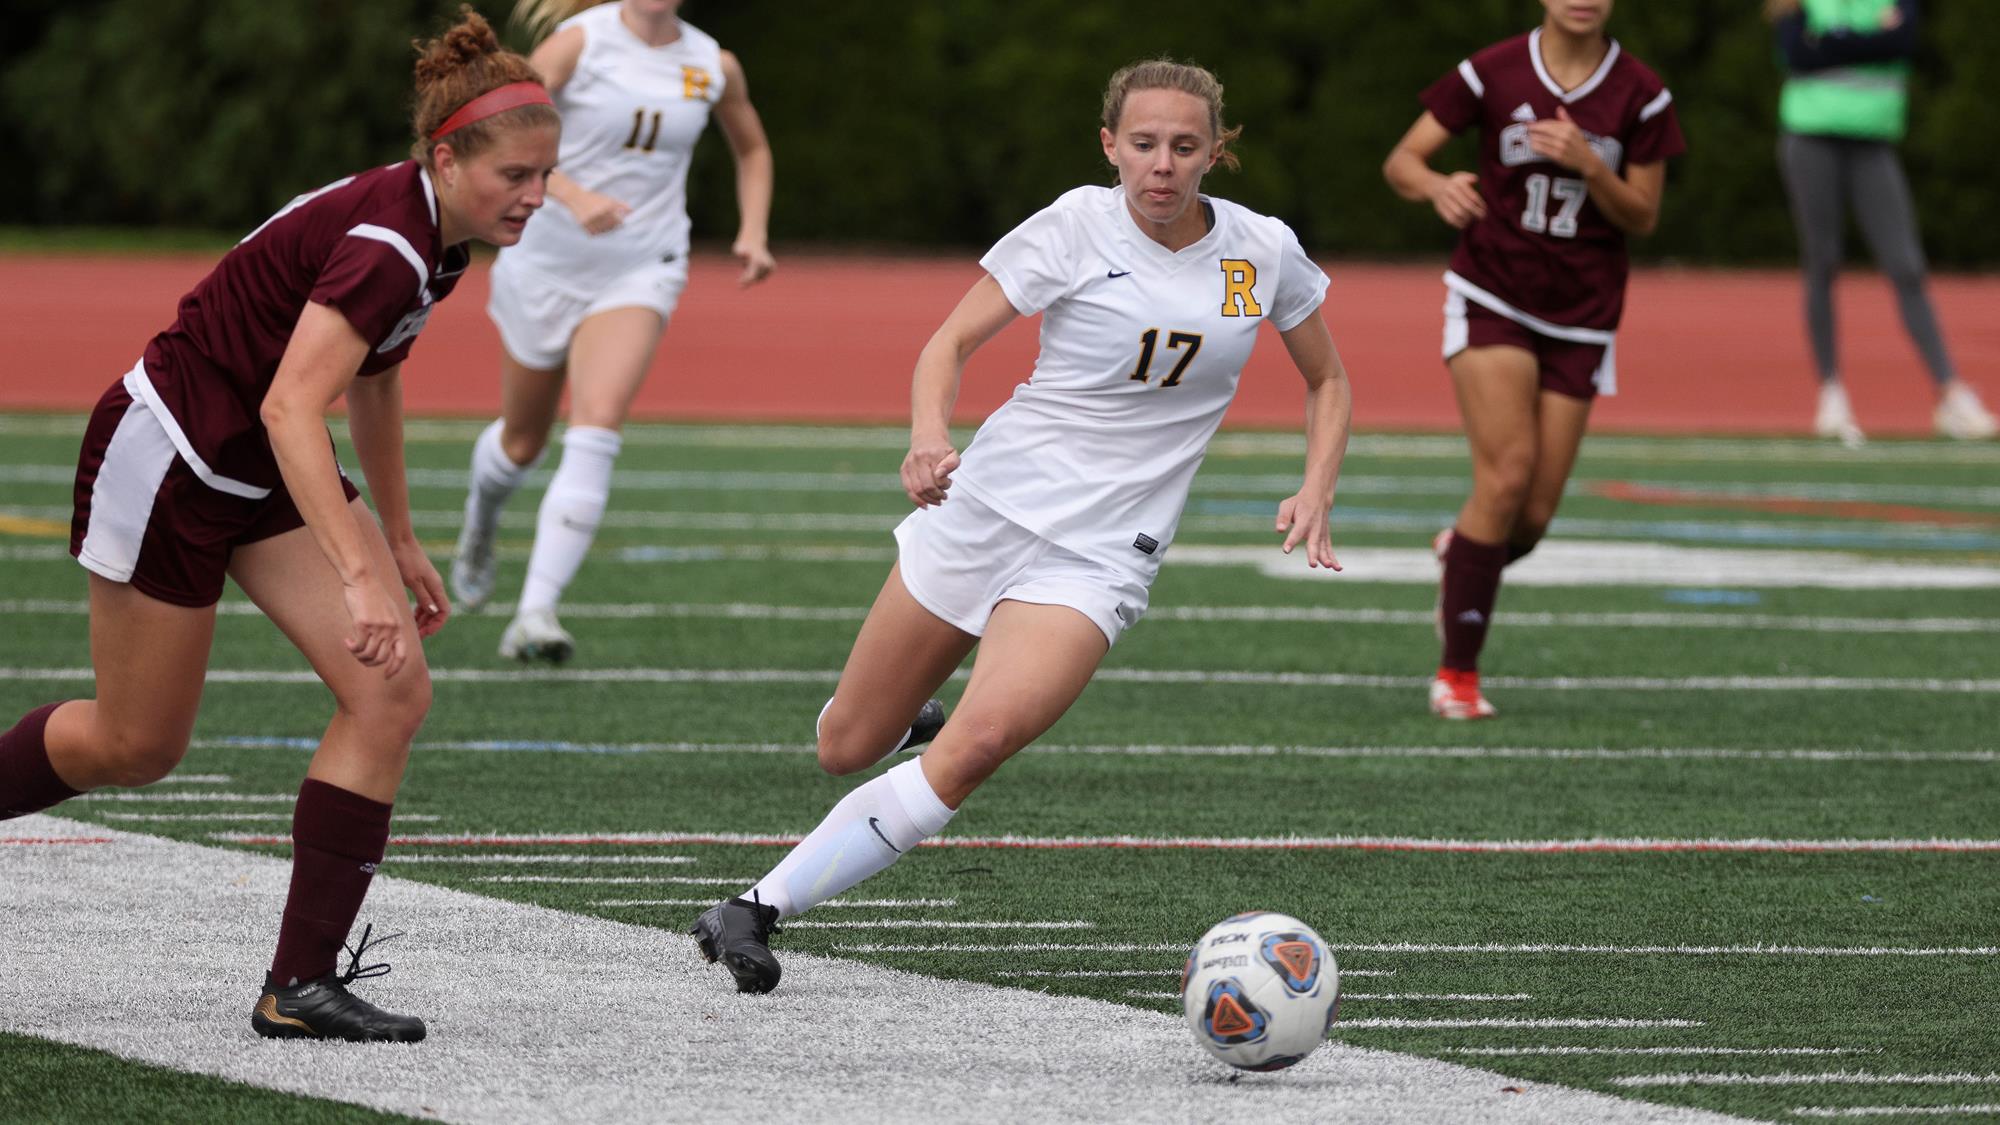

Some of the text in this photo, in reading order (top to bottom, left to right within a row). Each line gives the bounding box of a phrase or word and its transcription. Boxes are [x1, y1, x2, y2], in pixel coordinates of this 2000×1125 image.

[623, 106, 662, 154] 11
[1521, 173, 1588, 238] 17
[1220, 259, 1262, 317] R
[1129, 327, 1204, 388] 17
